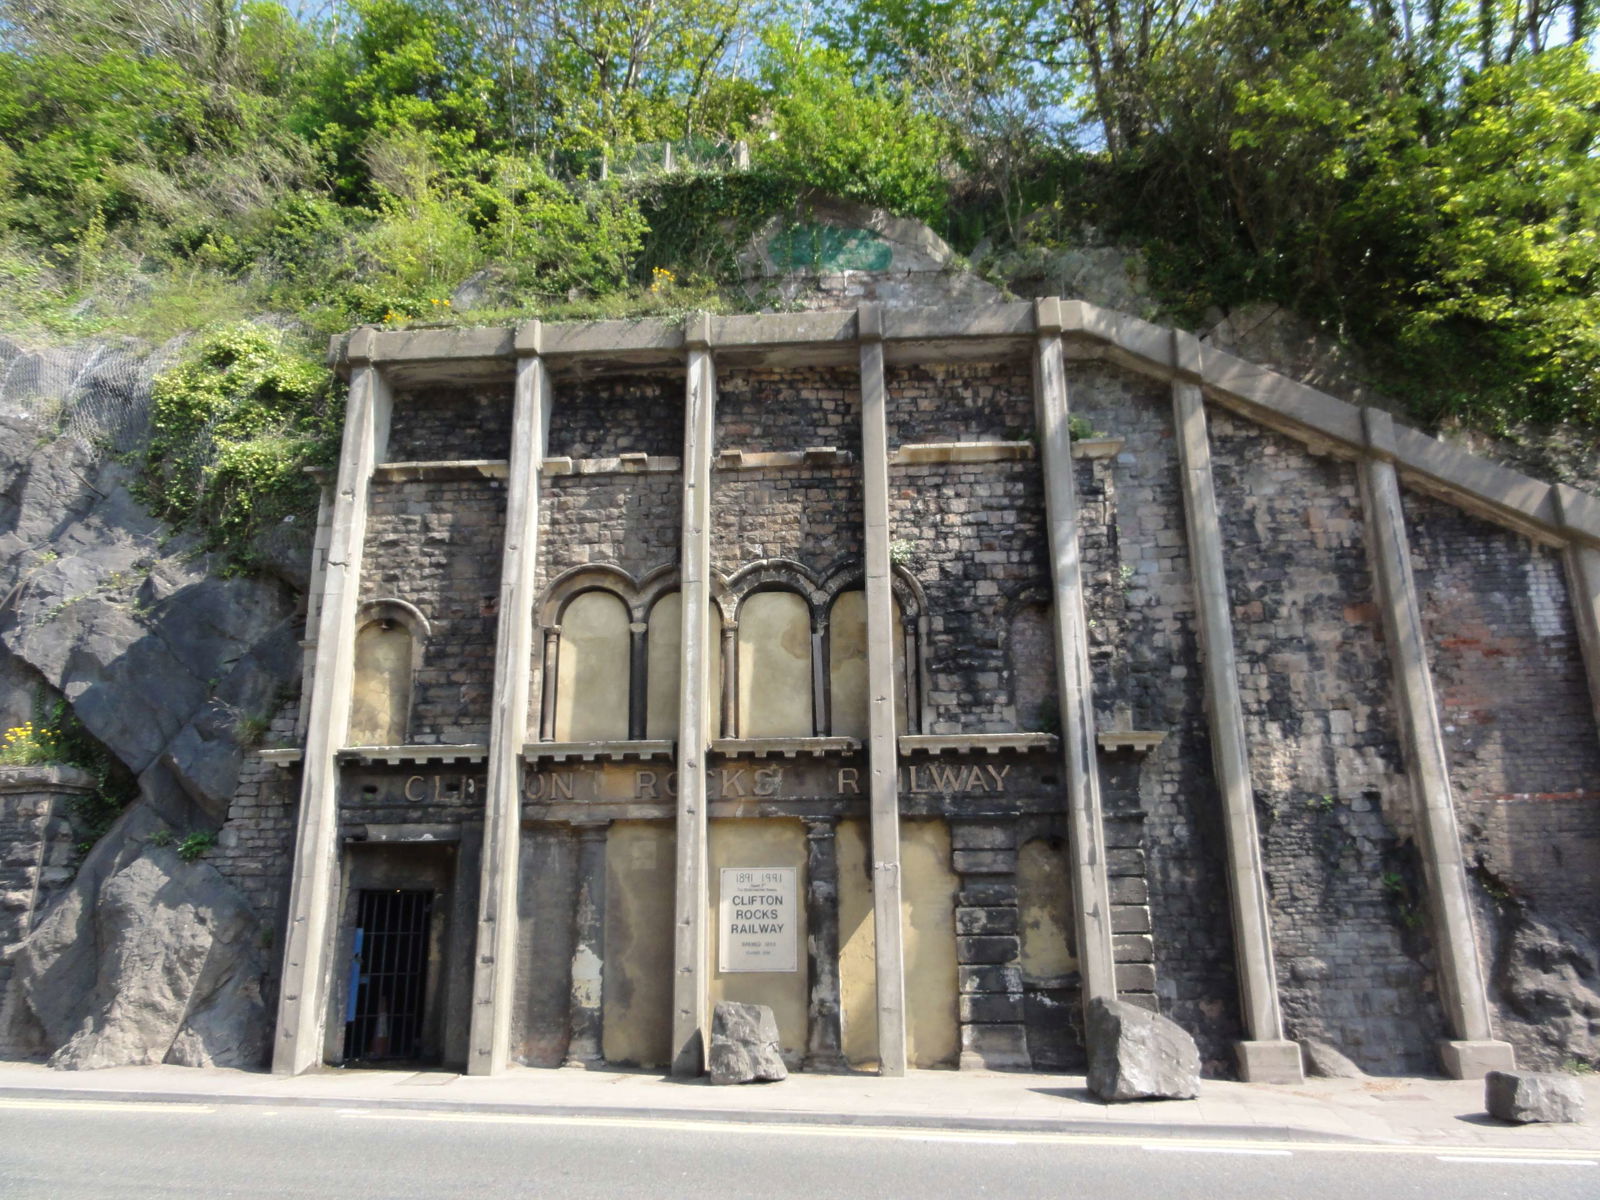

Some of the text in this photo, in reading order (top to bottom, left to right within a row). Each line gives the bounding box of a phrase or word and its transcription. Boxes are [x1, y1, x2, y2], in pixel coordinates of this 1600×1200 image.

[404, 771, 574, 802] CLIFON
[837, 764, 1011, 794] RILWAY
[735, 872, 753, 883] 1891
[732, 895, 783, 906] CLIFTON
[736, 909, 778, 920] ROCKS
[730, 923, 784, 934] RAILWAY
